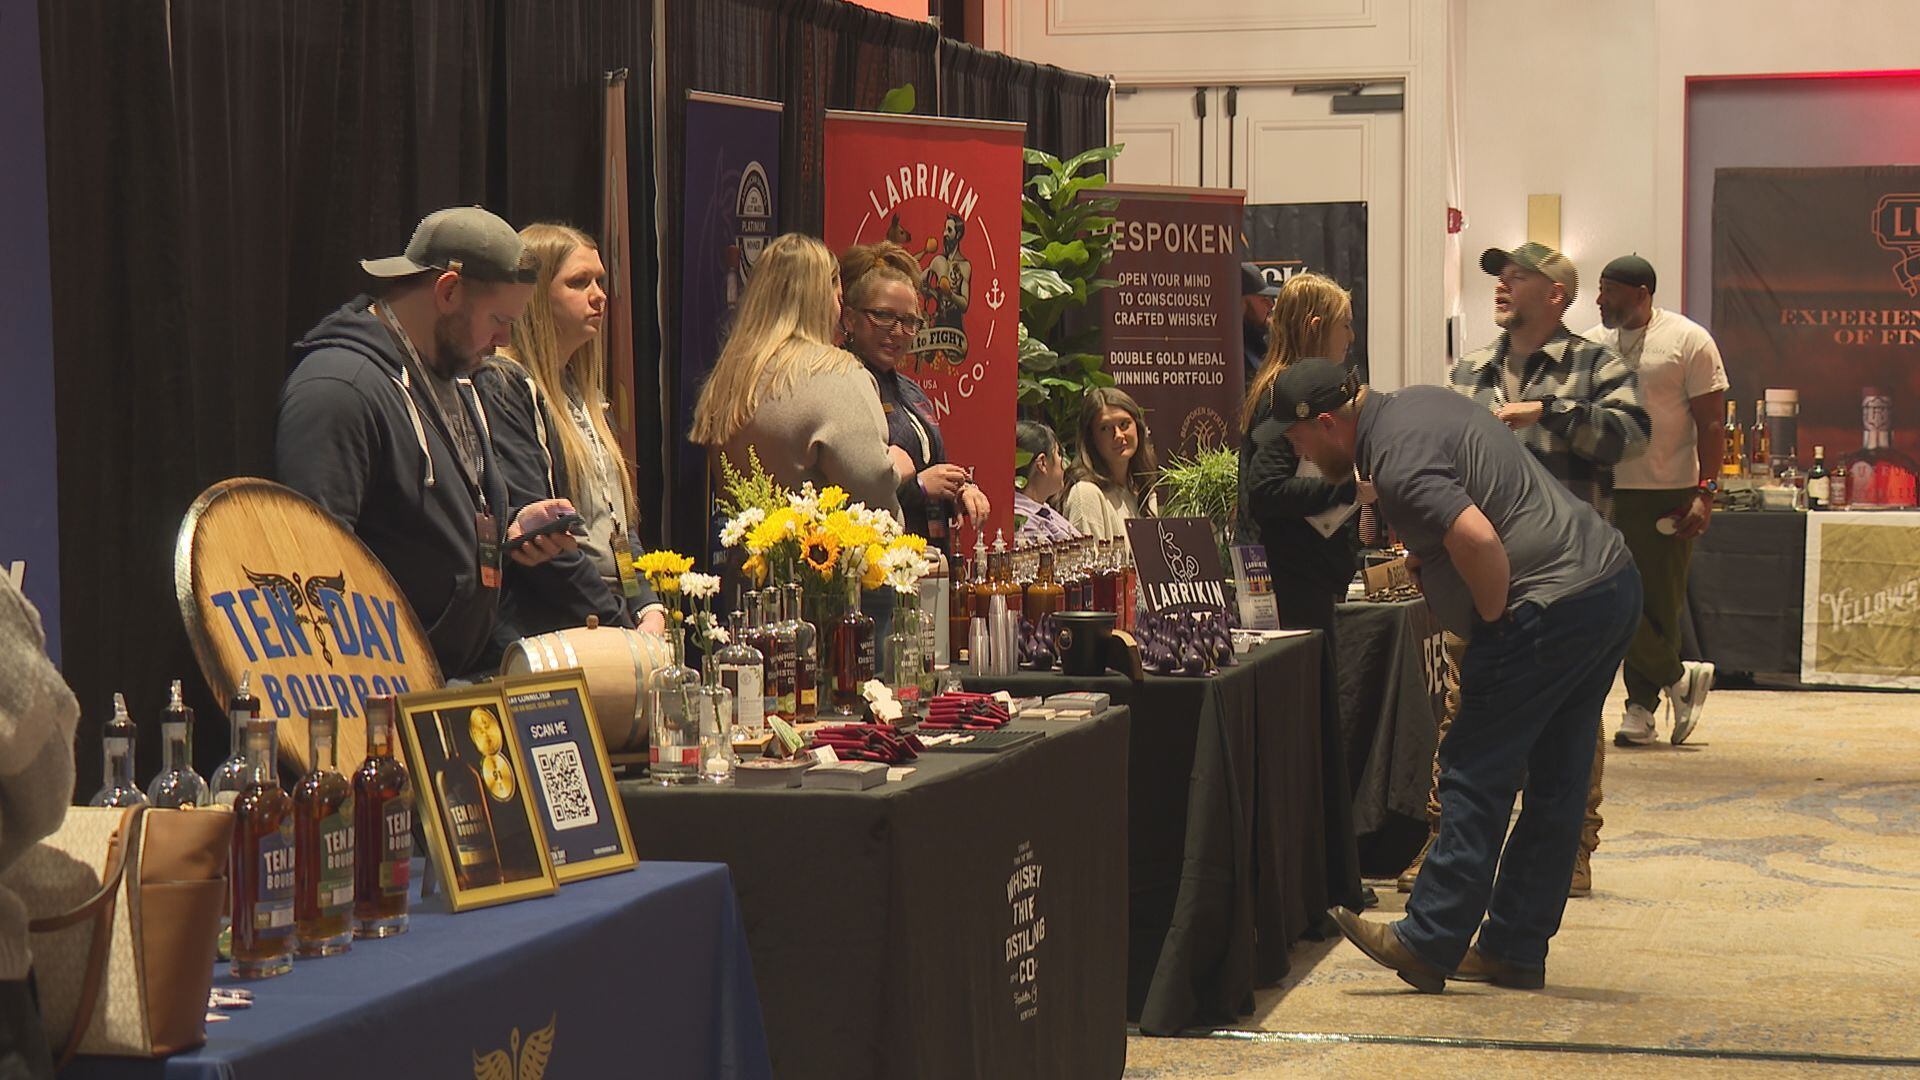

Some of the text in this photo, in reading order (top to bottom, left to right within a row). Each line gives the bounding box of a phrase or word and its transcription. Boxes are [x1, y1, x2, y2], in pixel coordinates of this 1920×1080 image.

[869, 163, 979, 222] LARRIKIN
[742, 220, 766, 233] PLATINUM
[1092, 221, 1233, 254] ESPOKEN
[1118, 272, 1211, 287] OPEN YOUR MIND
[1119, 292, 1211, 307] TO CONSCIOUSLY
[1114, 312, 1218, 327] CRAFTED WHISKEY
[929, 331, 964, 348] FIGHT
[1833, 329, 1873, 344] OF
[1110, 351, 1226, 366] DOUBLE GOLD MEDAL
[923, 380, 937, 390] USA
[1113, 371, 1224, 385] WINNING PORTFOLIO
[1148, 580, 1226, 612] LARRIKIN
[211, 585, 405, 664] TEN DAY
[530, 721, 568, 739] SCAN ME
[386, 811, 408, 835] TEN
[450, 805, 469, 824] TEN
[324, 828, 348, 853] TEN
[264, 848, 288, 873] TEN
